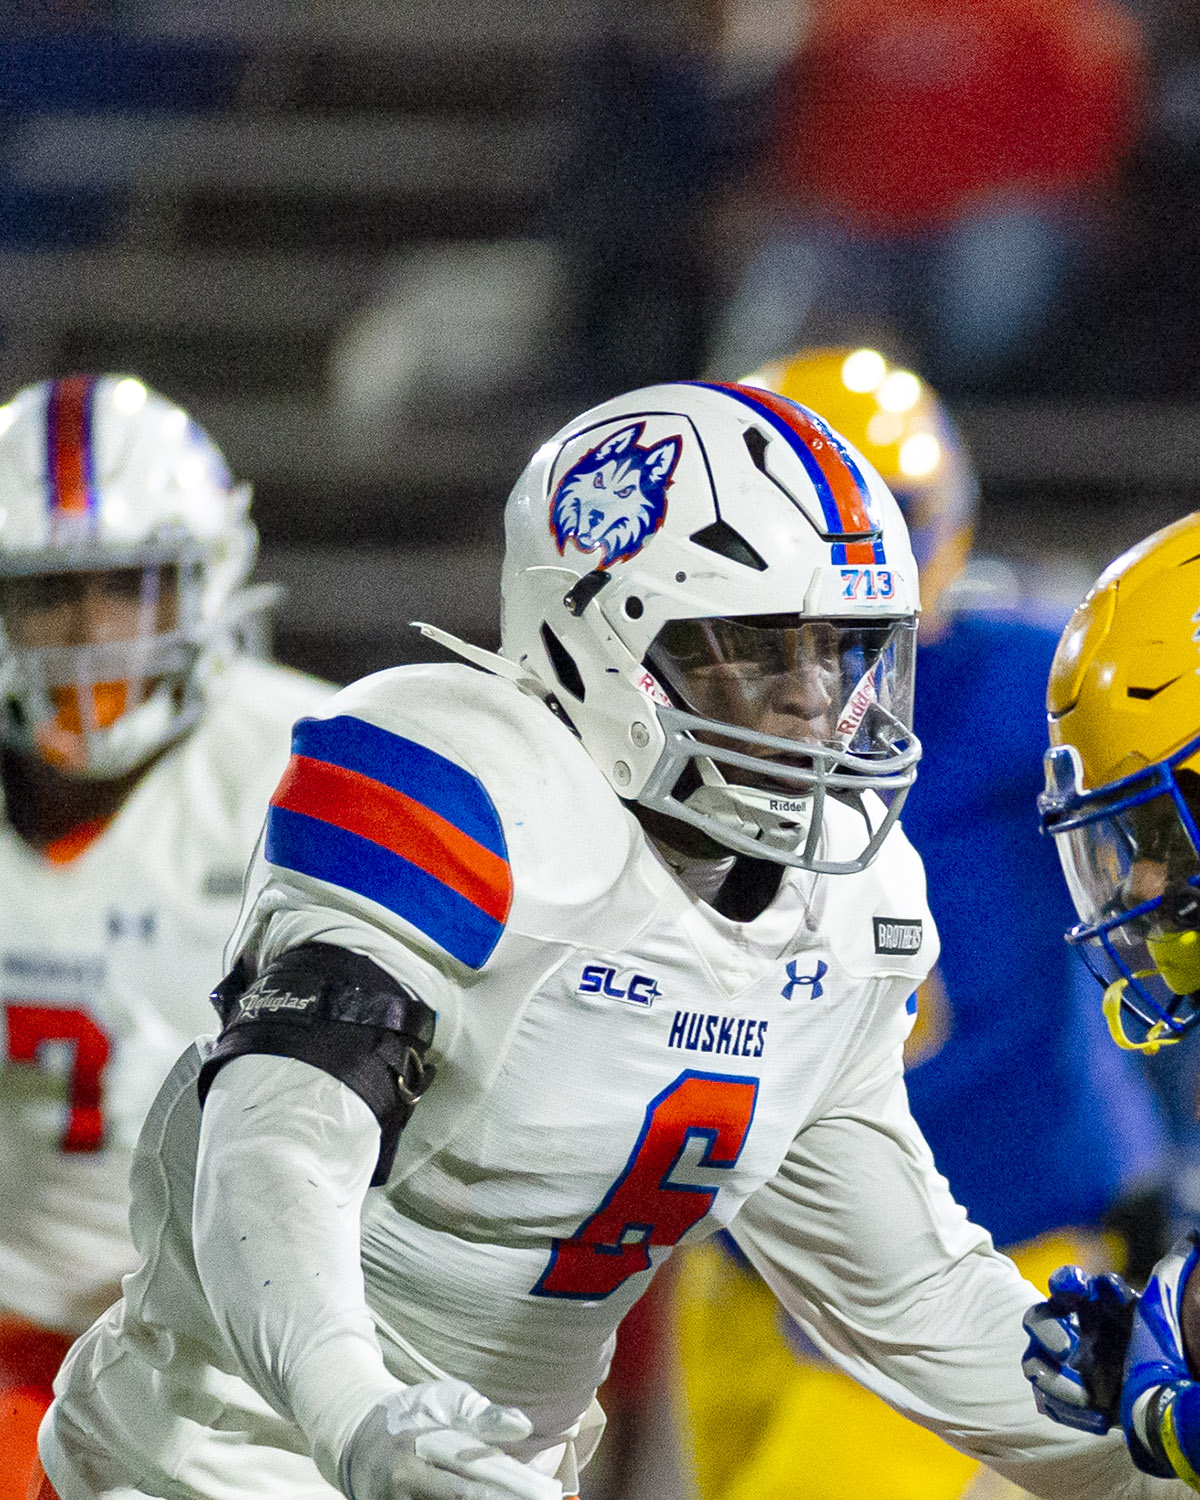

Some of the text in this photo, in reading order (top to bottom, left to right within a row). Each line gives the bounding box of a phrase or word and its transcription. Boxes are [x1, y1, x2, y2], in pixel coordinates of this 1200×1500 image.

[840, 569, 895, 600] 713
[5, 1001, 111, 1156] 7
[668, 1011, 768, 1057] HUSKIES
[529, 1069, 760, 1300] 6
